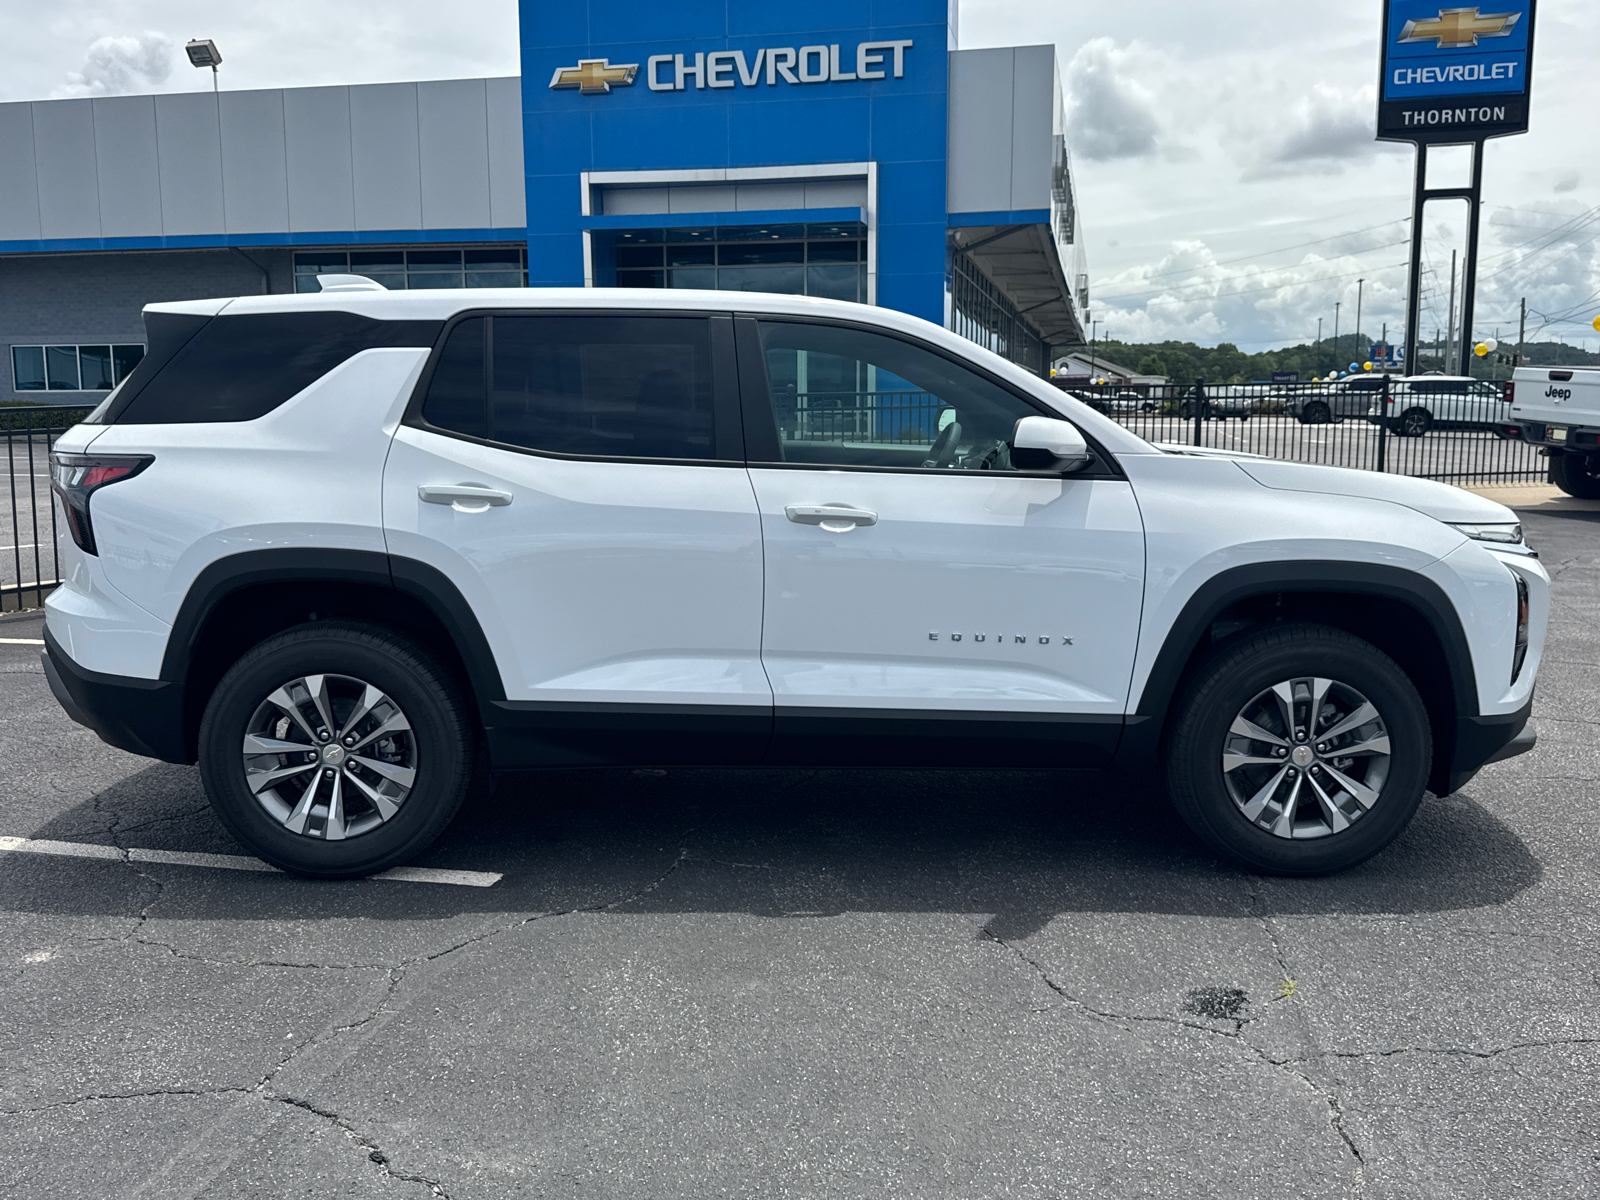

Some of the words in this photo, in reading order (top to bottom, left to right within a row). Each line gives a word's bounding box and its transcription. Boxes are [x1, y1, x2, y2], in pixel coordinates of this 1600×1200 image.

[647, 39, 913, 91] CHEVROLET
[1393, 62, 1518, 85] CHEVROLET
[1402, 106, 1505, 126] THORNTON
[1545, 385, 1571, 401] Jeep
[928, 631, 1074, 646] EQUINOX
